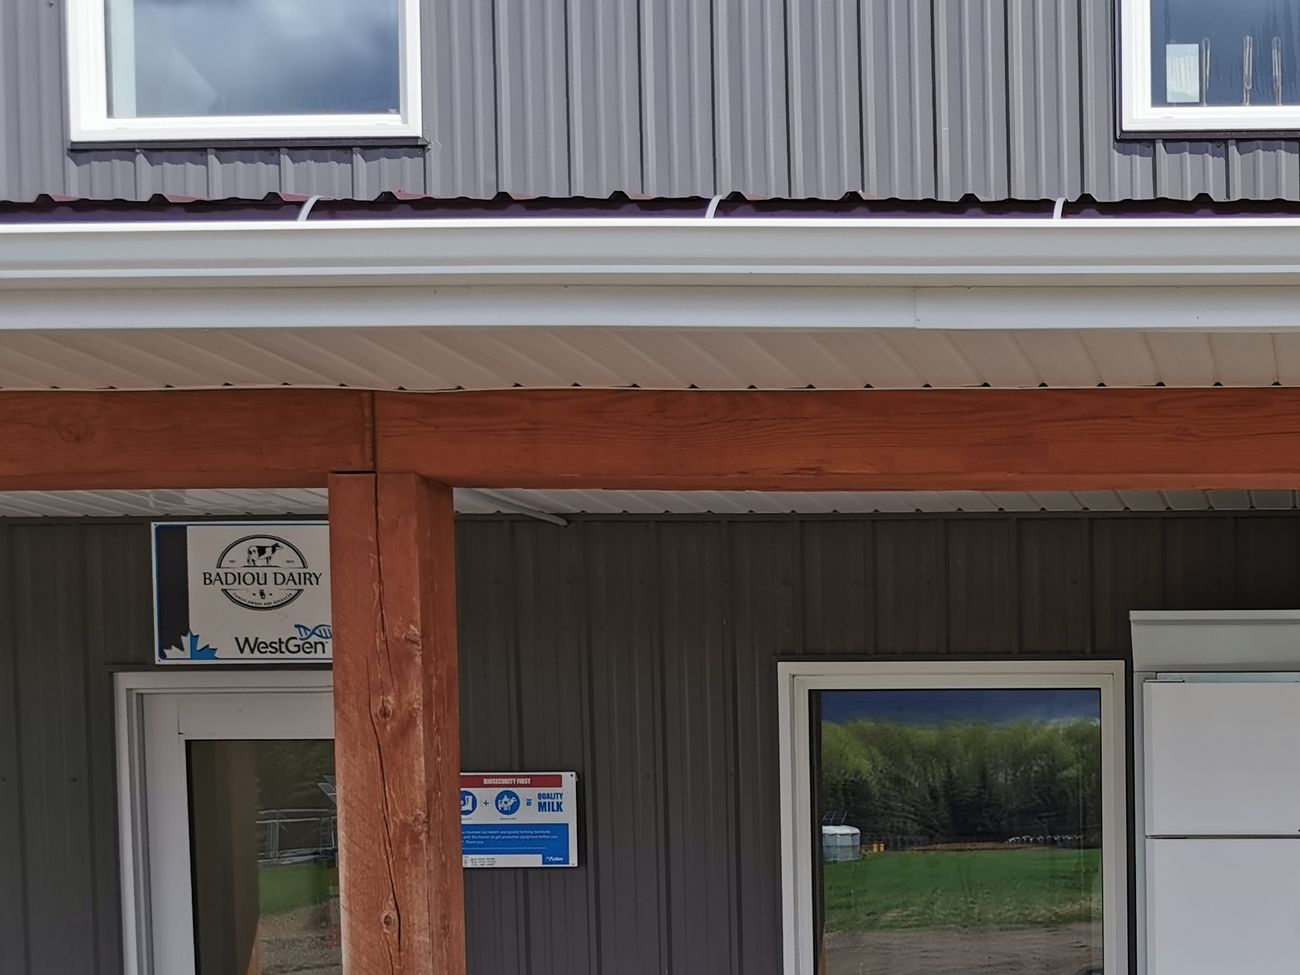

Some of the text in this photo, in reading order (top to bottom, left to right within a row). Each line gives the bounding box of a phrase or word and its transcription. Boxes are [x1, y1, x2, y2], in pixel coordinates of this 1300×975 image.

[202, 571, 322, 586] BADIOU DAIRY
[235, 636, 326, 655] WestGen
[537, 792, 563, 800] QUALITY
[537, 801, 563, 812] MILK
